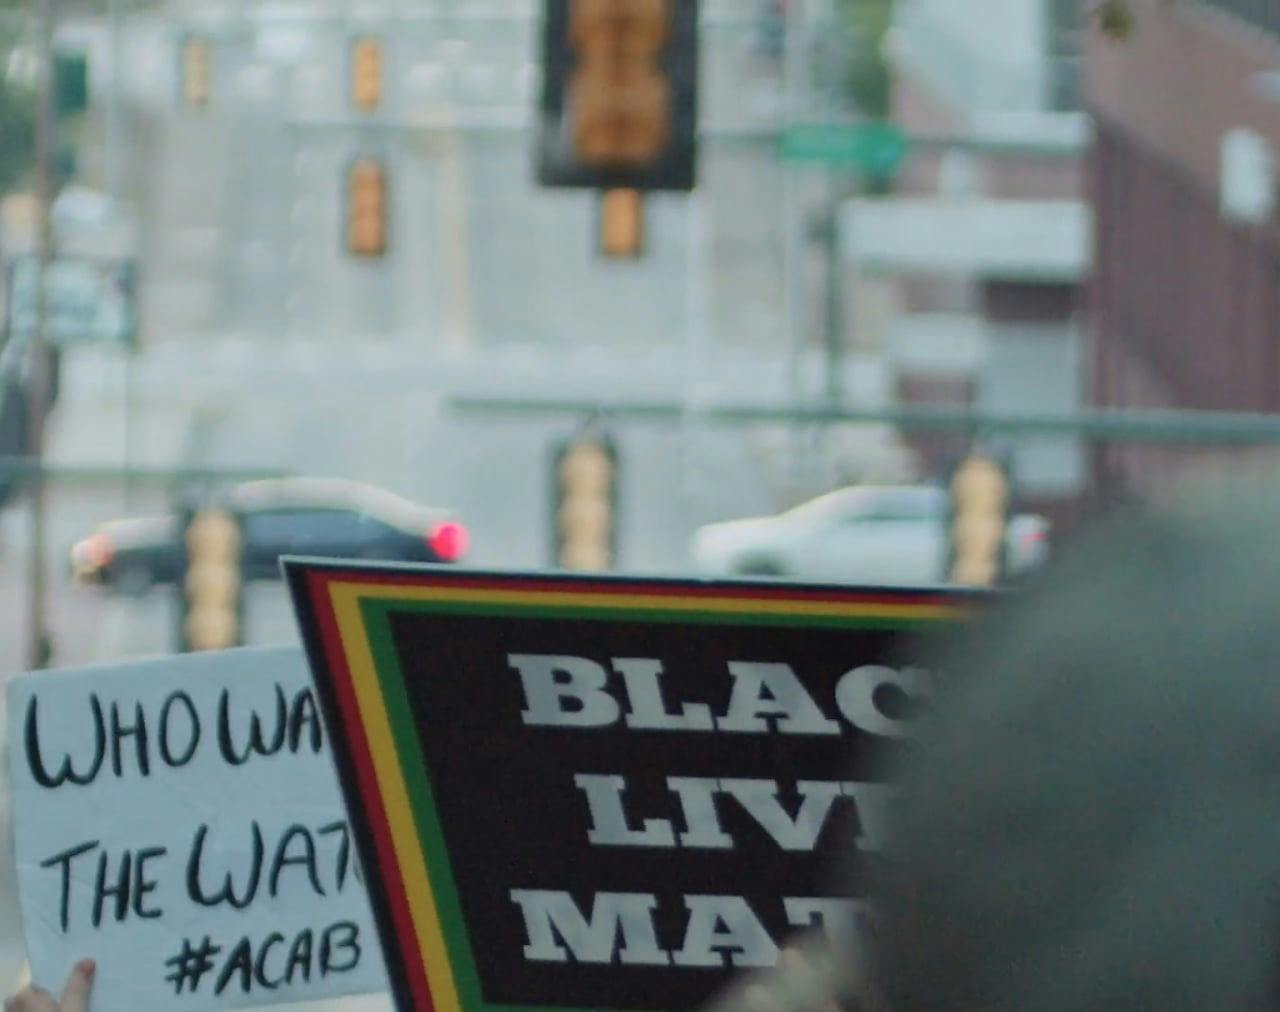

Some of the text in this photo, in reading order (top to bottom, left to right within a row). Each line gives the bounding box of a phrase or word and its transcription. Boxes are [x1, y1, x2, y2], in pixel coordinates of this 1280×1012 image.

[24, 689, 202, 788] WHO
[40, 819, 360, 934] THE WAT
[163, 920, 362, 997] #ACAB
